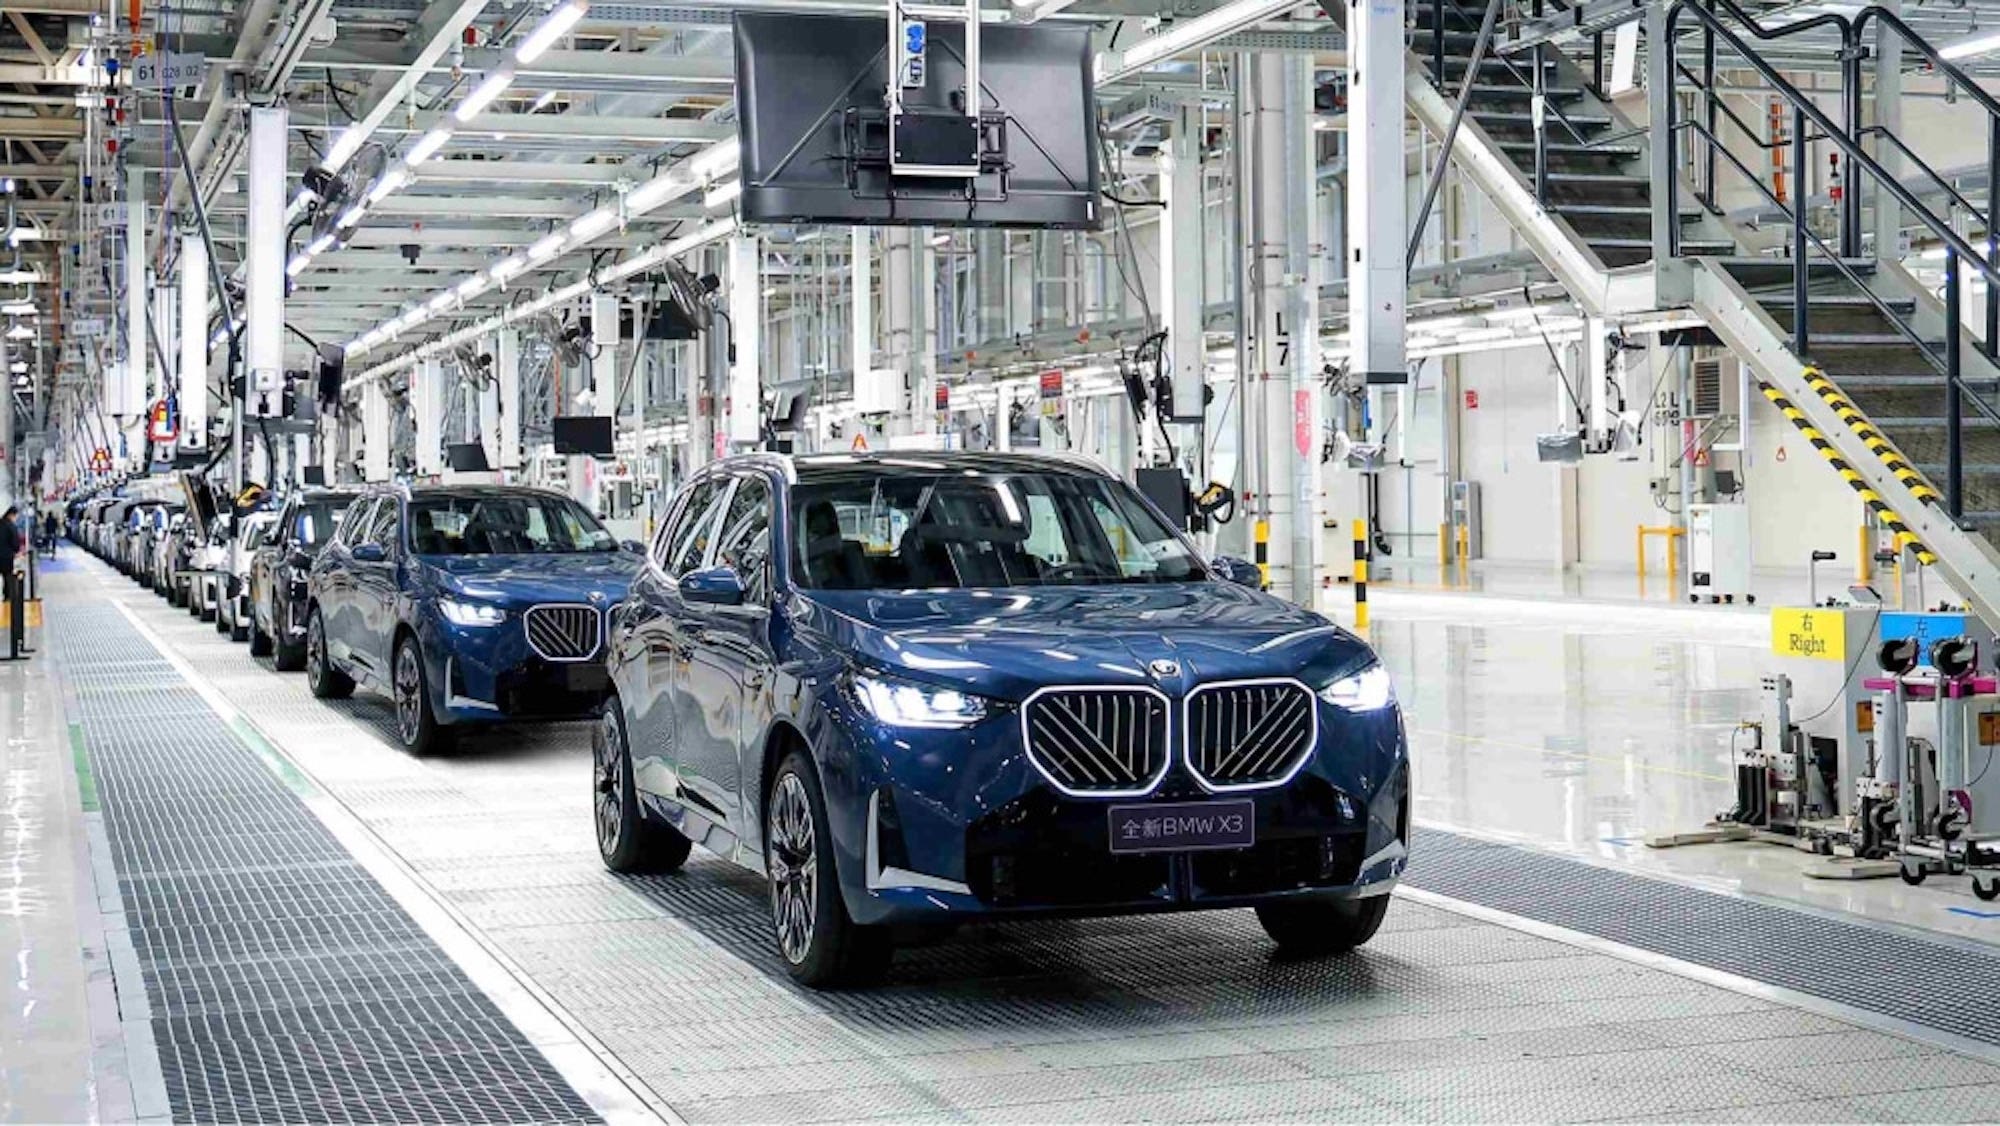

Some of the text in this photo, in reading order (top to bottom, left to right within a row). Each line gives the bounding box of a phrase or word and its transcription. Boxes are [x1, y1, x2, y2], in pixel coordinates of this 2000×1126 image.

[139, 65, 155, 80] 61
[1800, 613, 1813, 632] 右
[1916, 617, 1928, 638] 左
[1789, 633, 1825, 656] Right
[1217, 814, 1243, 833] X3
